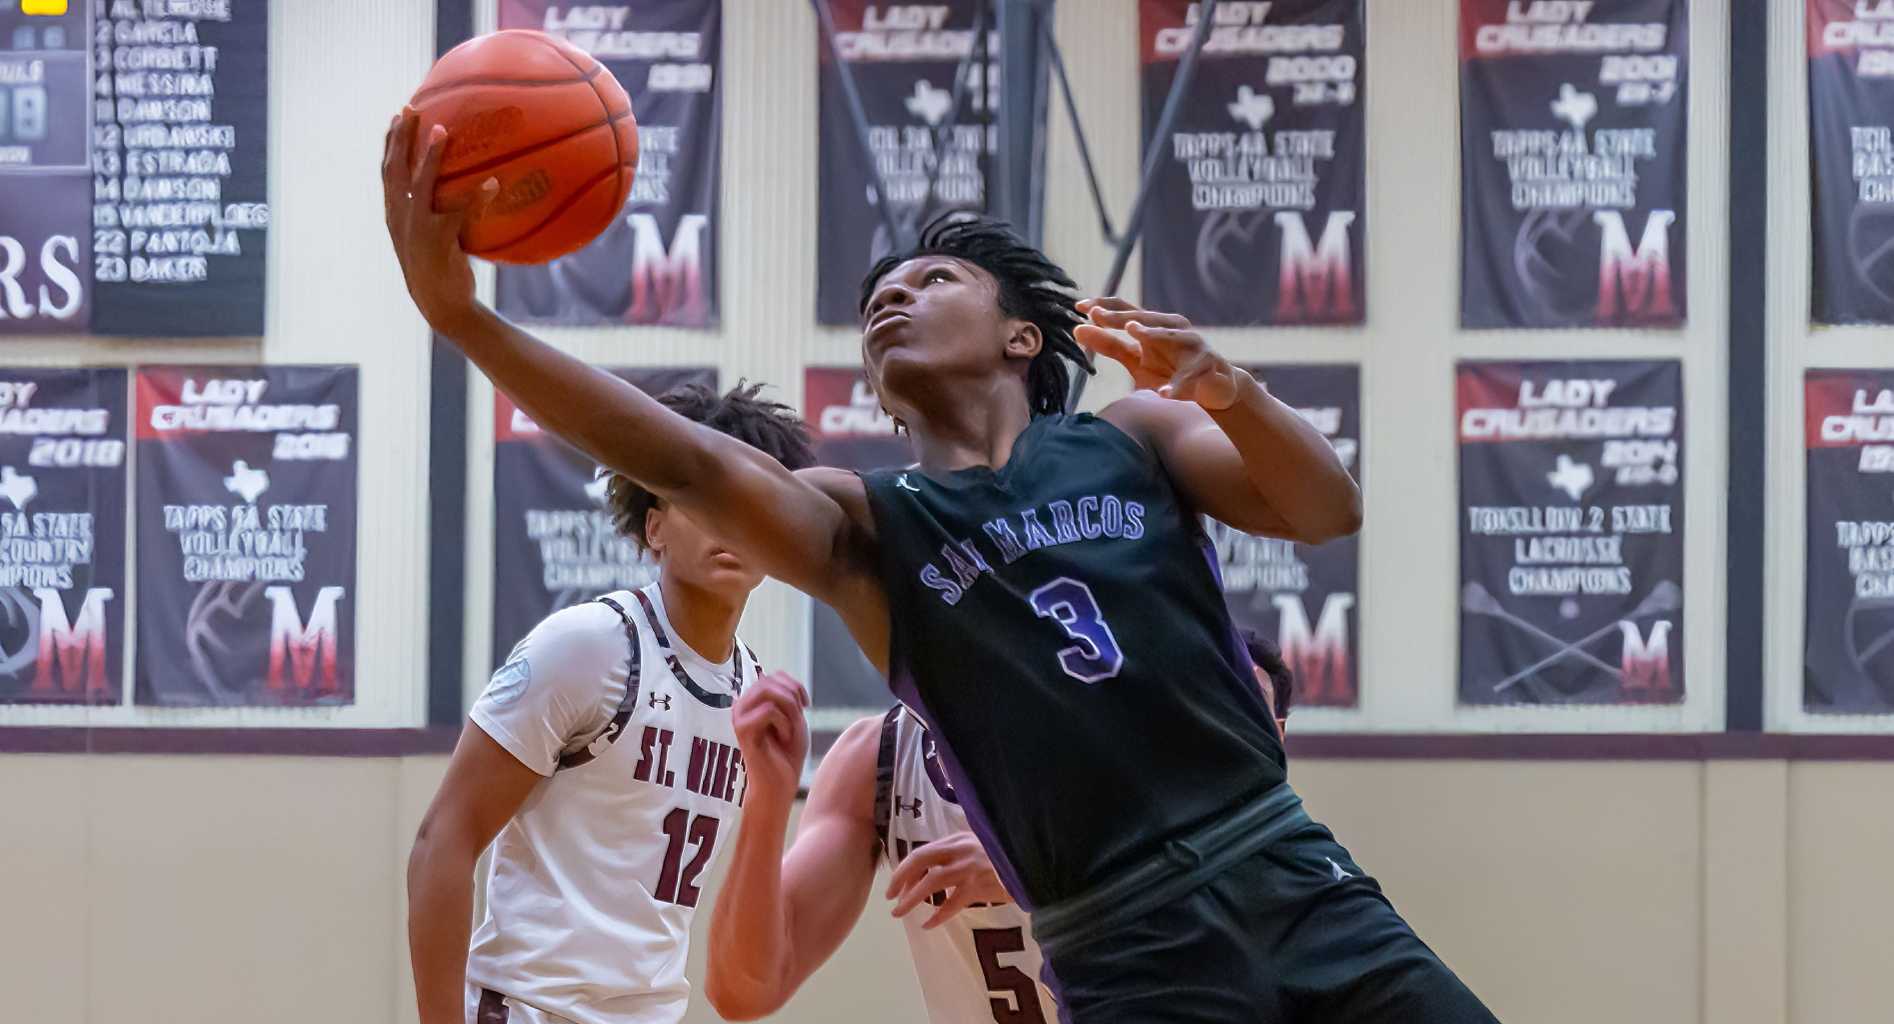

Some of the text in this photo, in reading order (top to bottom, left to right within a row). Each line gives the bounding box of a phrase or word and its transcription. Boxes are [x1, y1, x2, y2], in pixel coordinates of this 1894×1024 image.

[1475, 23, 1667, 51] CRUSADERS
[180, 379, 268, 406] LADY
[1518, 379, 1617, 407] LADY
[151, 403, 341, 431] CRUSADERS
[1462, 406, 1678, 438] CRUSADERS
[982, 494, 1146, 565] MARCOS
[1610, 505, 1673, 534] STATE
[1515, 536, 1624, 564] LACROSSE
[183, 556, 305, 583] CHAMPIONS
[1508, 566, 1633, 595] CHAMPIONS
[1028, 576, 1124, 684] 3
[654, 807, 720, 909] 12
